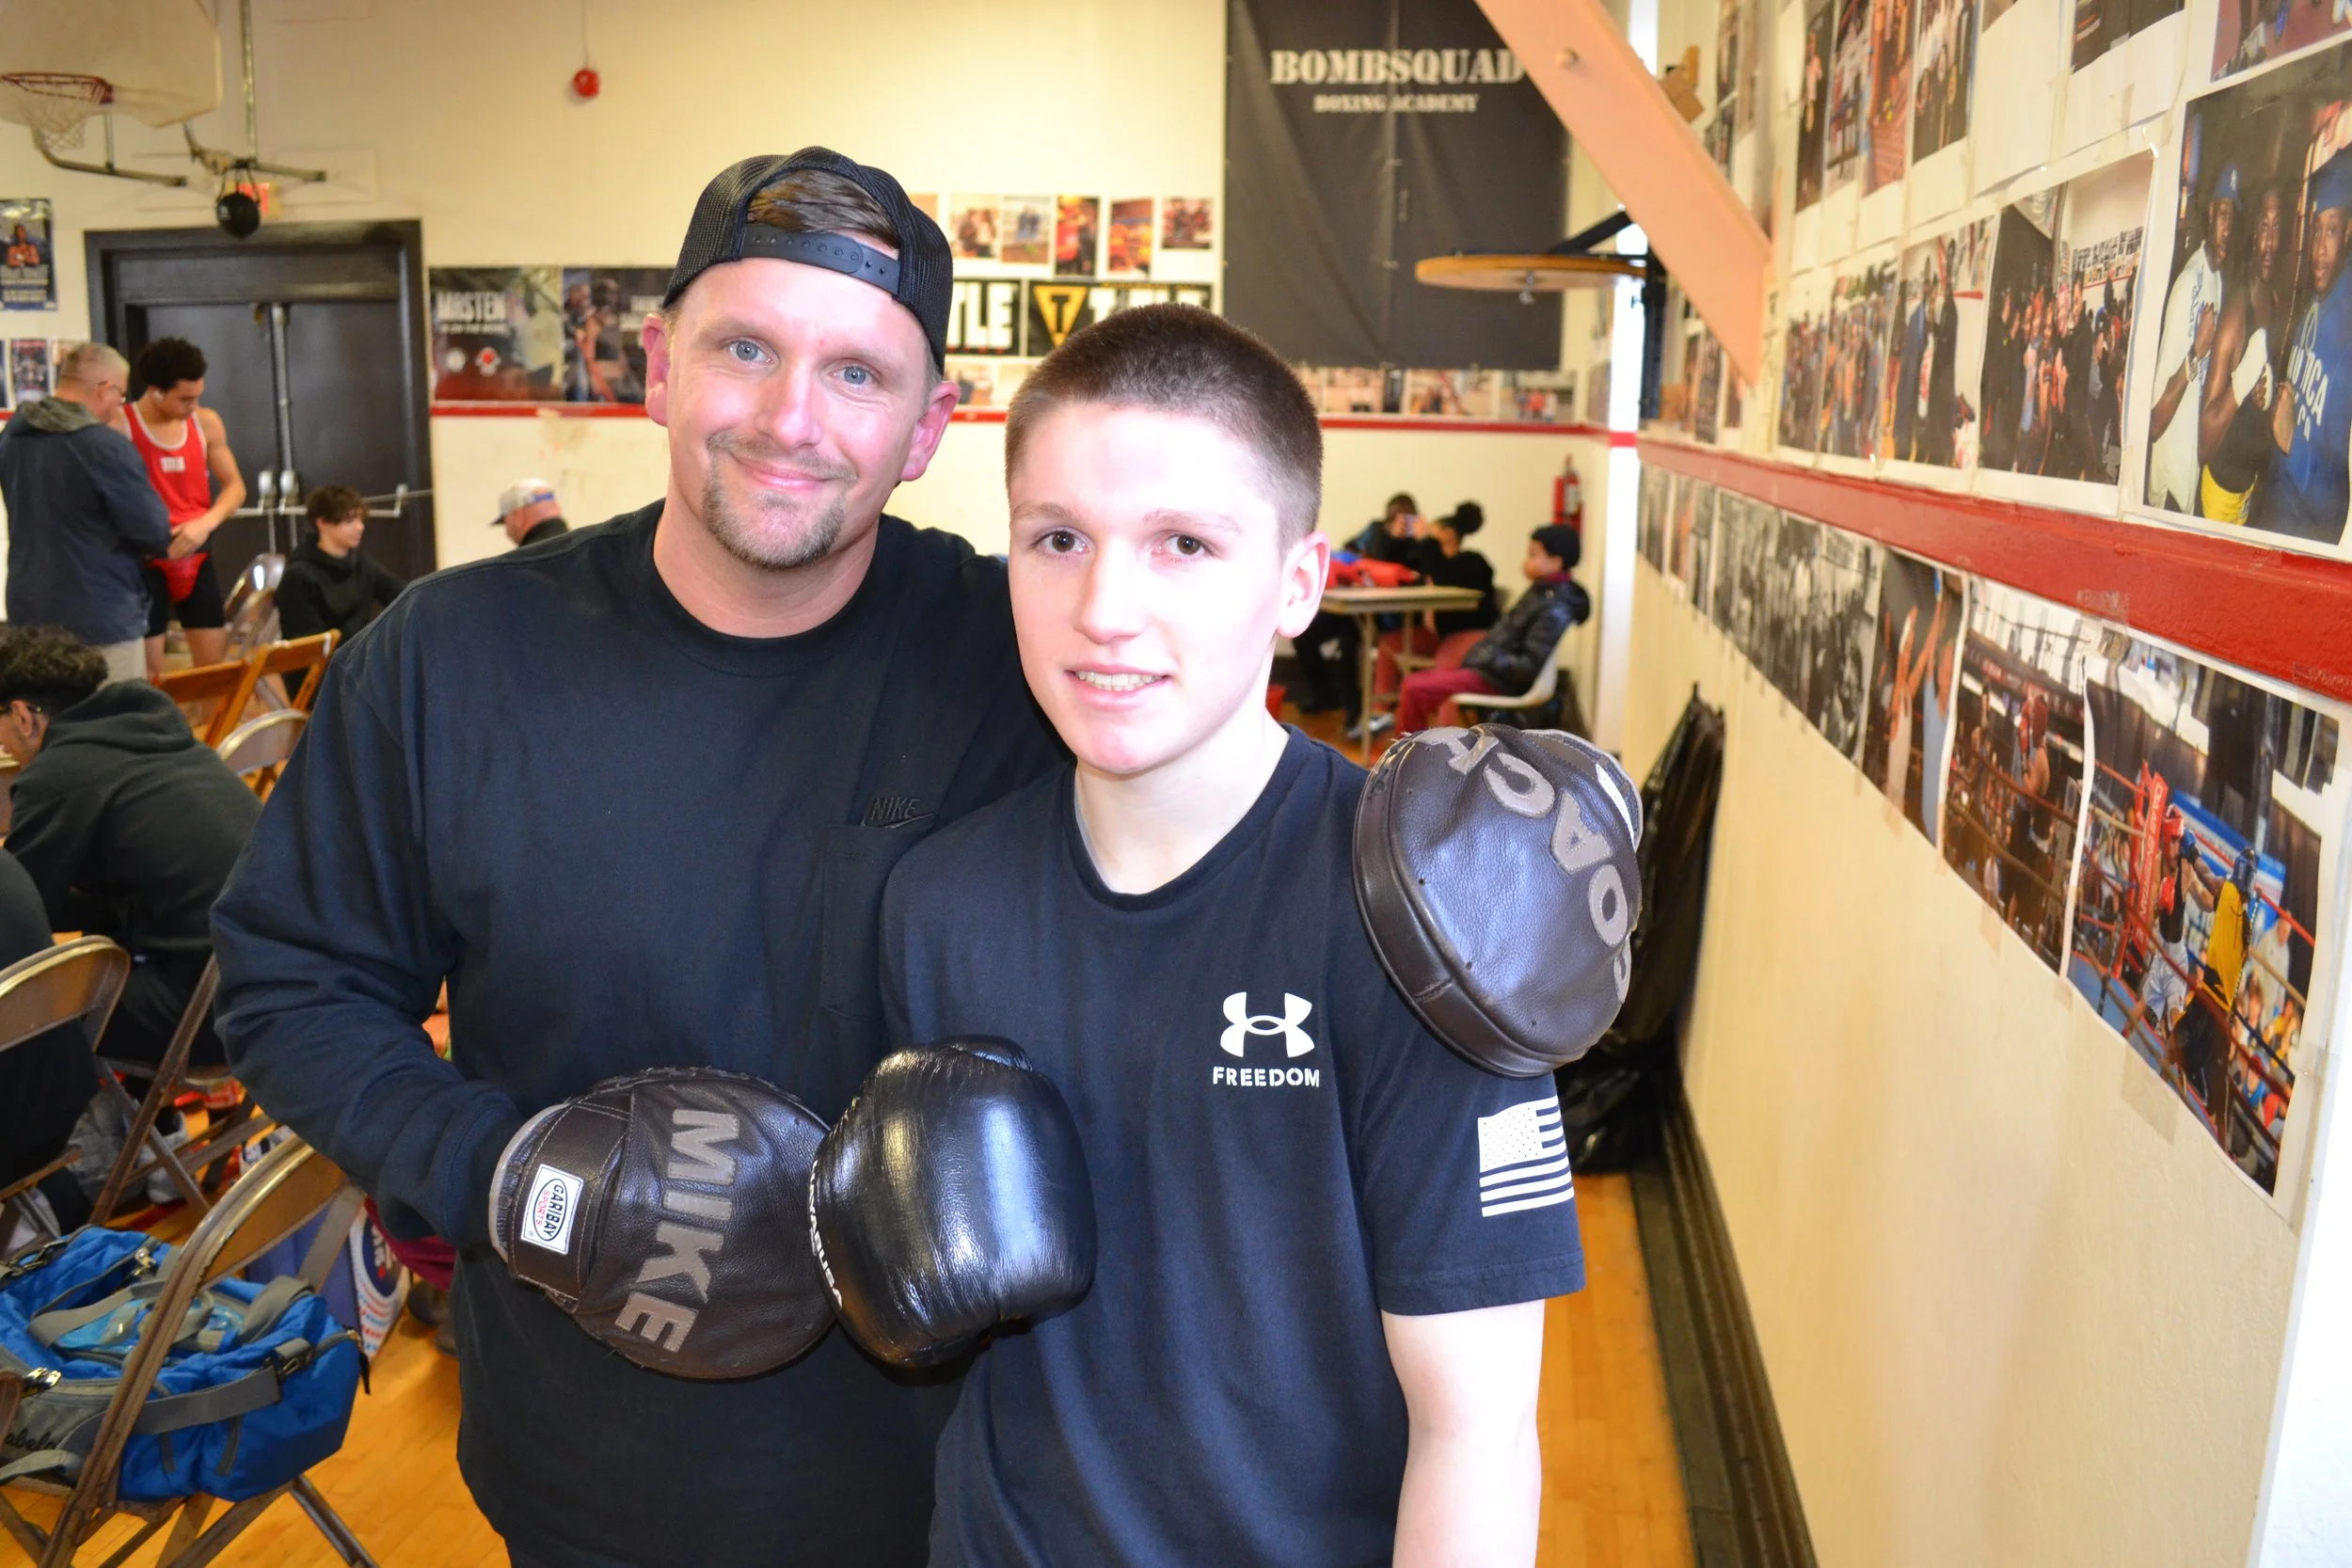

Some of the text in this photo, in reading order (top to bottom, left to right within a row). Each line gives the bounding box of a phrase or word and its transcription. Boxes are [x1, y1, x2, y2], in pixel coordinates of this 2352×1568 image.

[1270, 49, 1524, 85] BOMBSQUAD
[1313, 94, 1481, 113] BOXING ACADEMY
[870, 797, 920, 820] NIKE
[1213, 1066, 1320, 1087] FREEDOM
[535, 1189, 551, 1227] SPORTS
[543, 1184, 564, 1238] GARIBAY
[614, 1109, 740, 1353] MIKE
